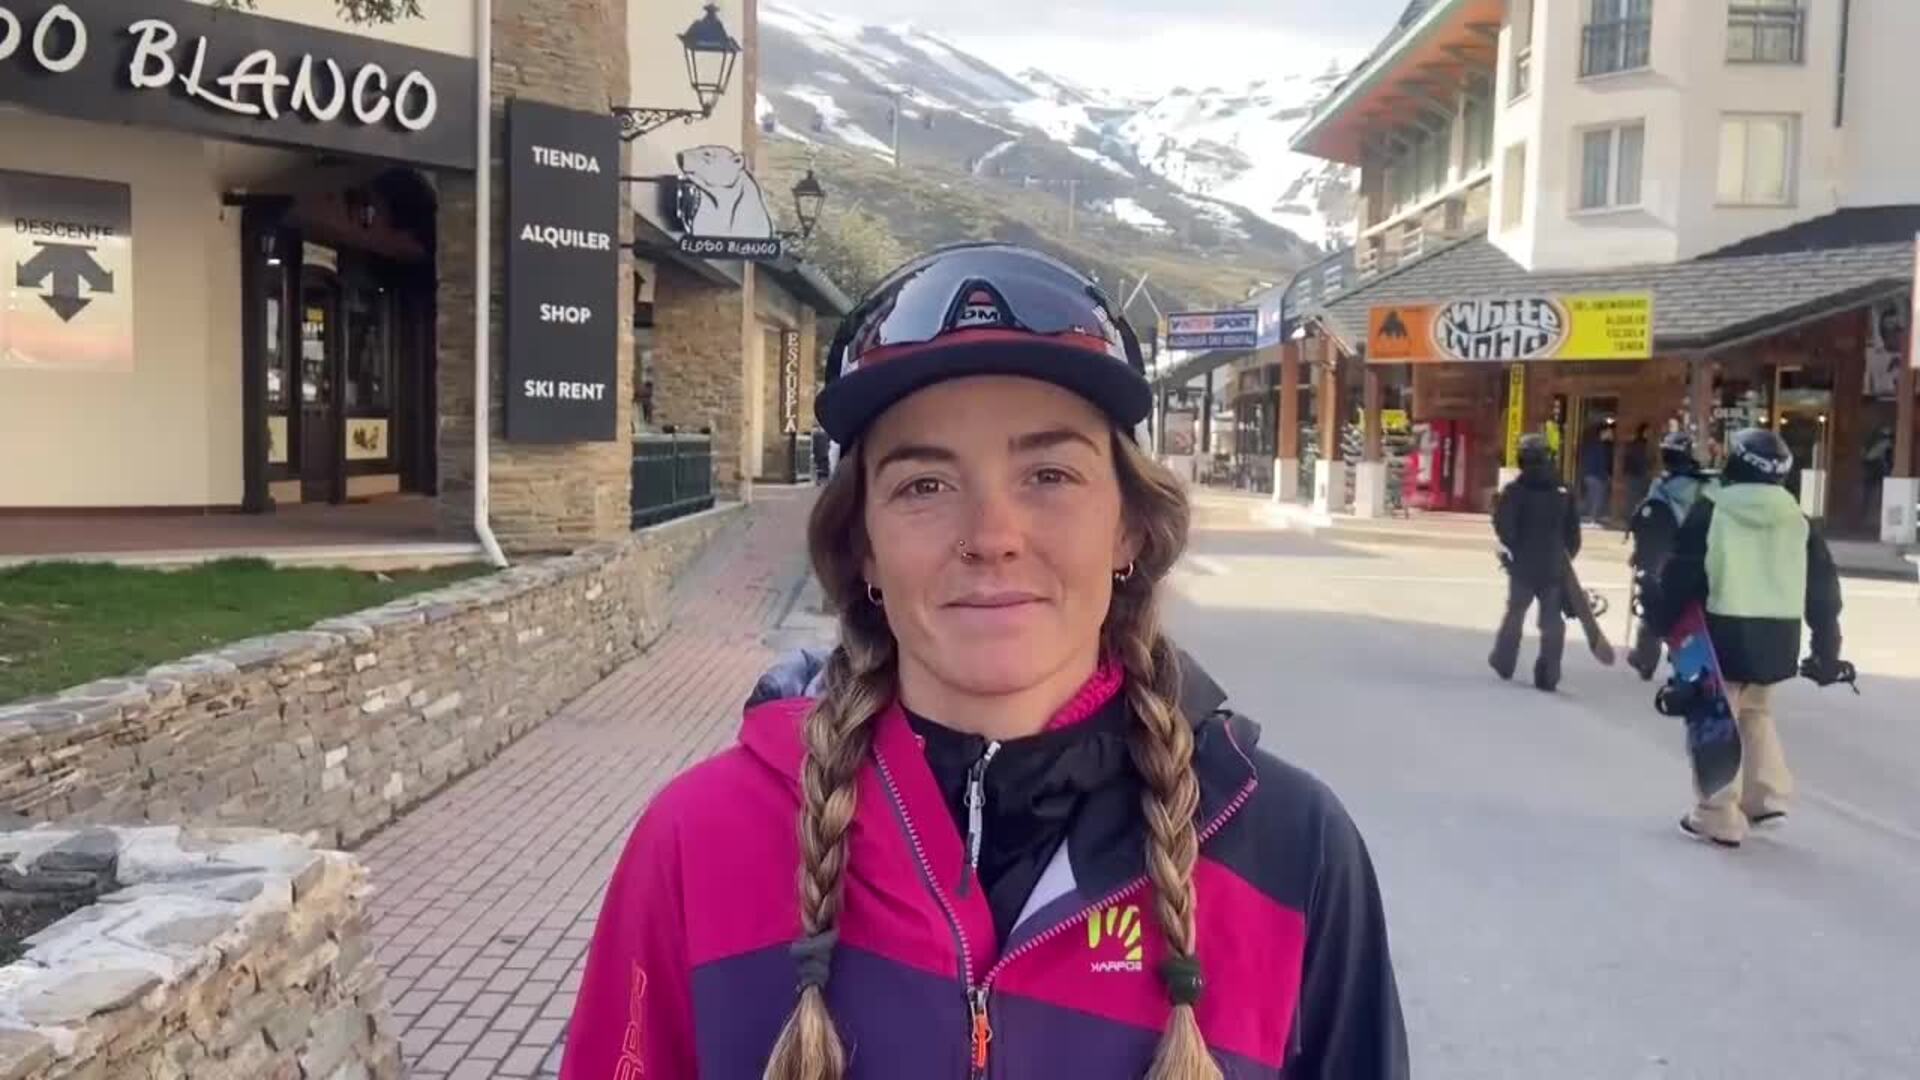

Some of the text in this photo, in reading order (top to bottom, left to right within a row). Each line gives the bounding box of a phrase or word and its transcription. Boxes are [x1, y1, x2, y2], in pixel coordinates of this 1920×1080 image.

[127, 19, 437, 131] BLANCO
[532, 146, 600, 173] TIENDA
[15, 217, 112, 240] DESCENTE
[520, 224, 611, 250] ALQUILER
[540, 304, 592, 324] SHOP
[1449, 299, 1560, 333] White
[1444, 325, 1549, 358] World
[524, 380, 605, 400] SKI RENT
